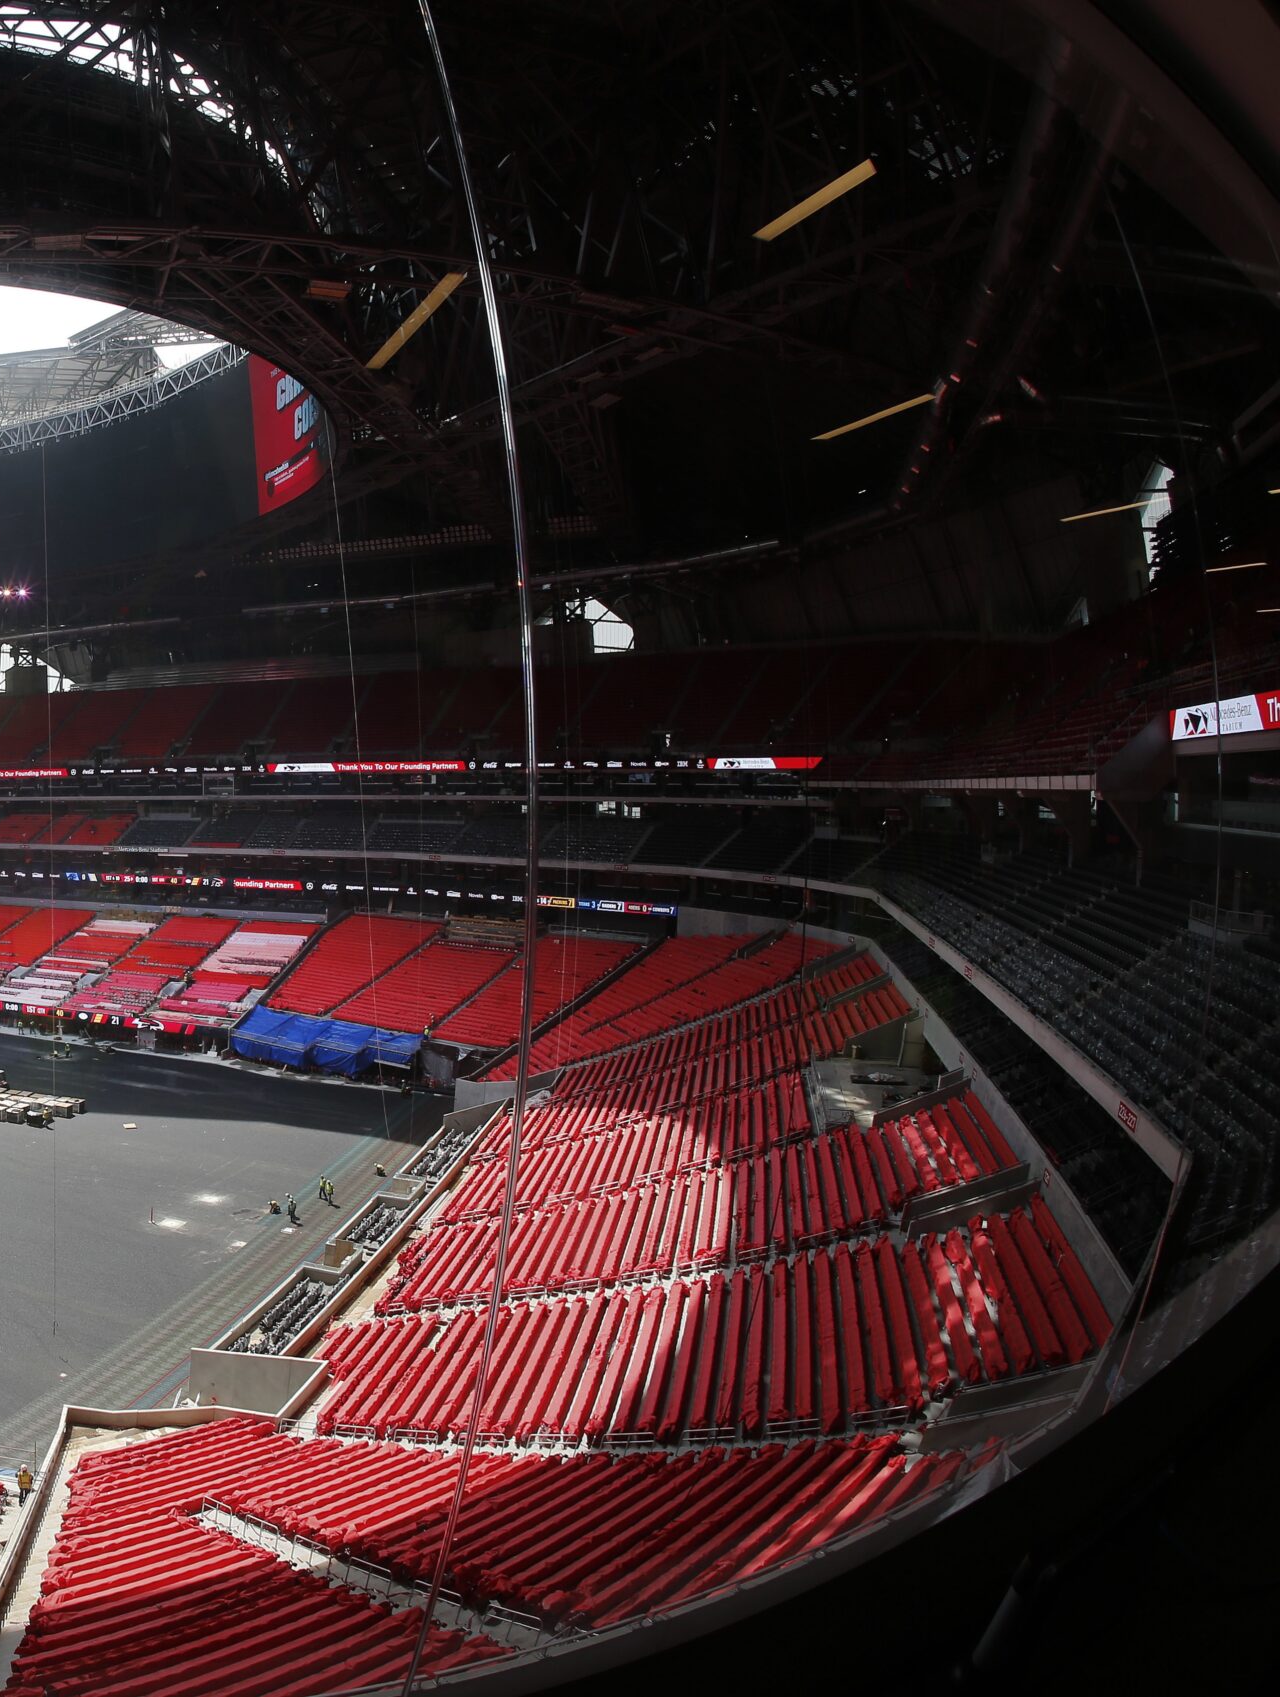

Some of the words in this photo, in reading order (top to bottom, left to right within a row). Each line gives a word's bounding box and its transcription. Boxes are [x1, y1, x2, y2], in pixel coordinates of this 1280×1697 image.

[400, 763, 430, 771] Founding
[676, 760, 689, 768] IBM
[265, 881, 294, 889] Partners
[511, 895, 523, 903] IBM
[5, 1002, 19, 1011] 0:00
[56, 1009, 64, 1017] 40
[111, 1015, 119, 1025] 21
